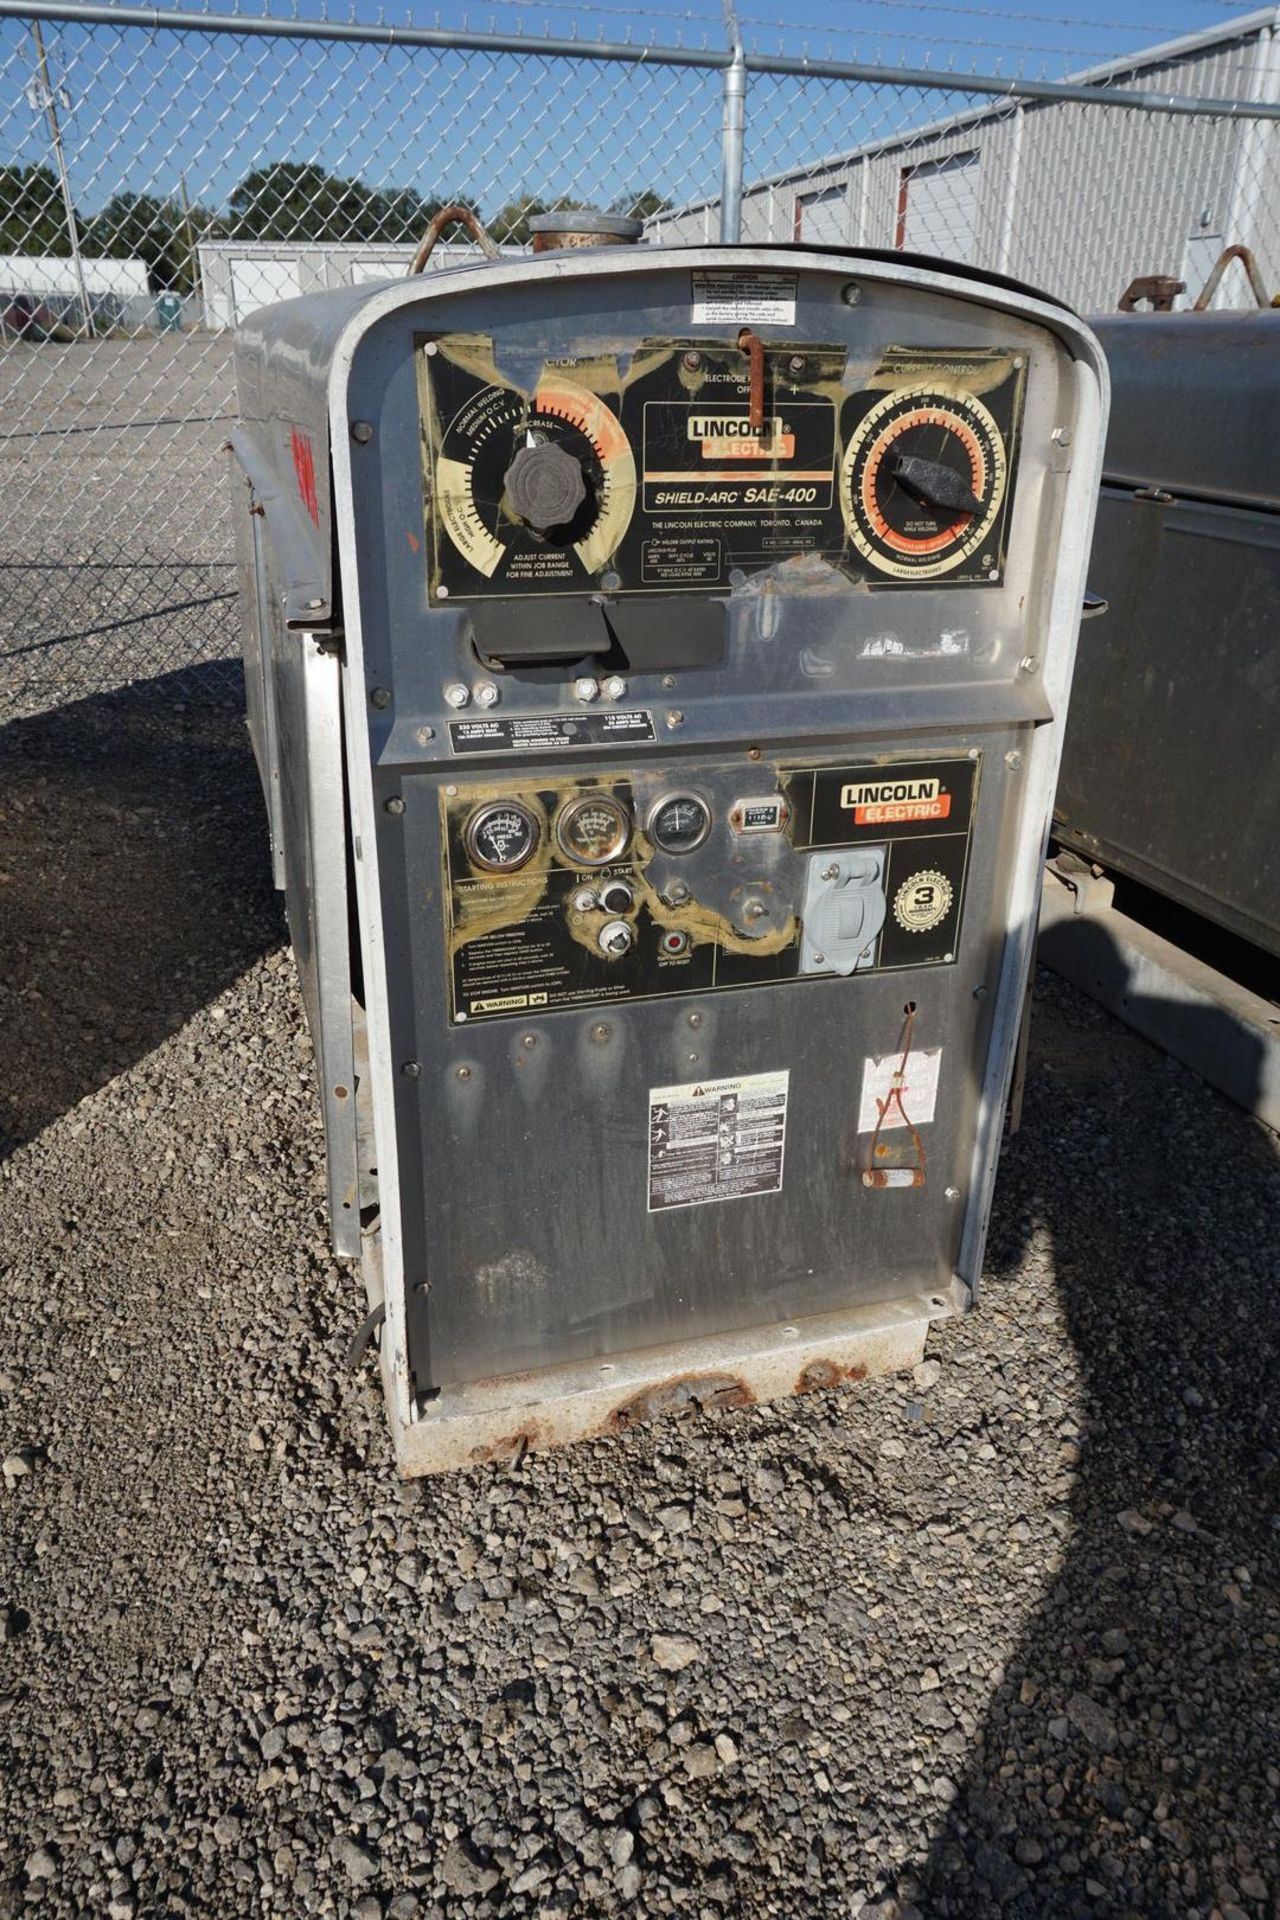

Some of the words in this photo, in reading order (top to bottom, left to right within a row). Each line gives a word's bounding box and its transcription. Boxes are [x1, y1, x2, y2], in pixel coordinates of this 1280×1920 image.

[704, 374, 746, 383] ELECTRODE
[456, 407, 480, 434] NORMAL
[476, 388, 505, 409] WELDING
[655, 492, 738, 504] SHIELD-ARC
[744, 488, 818, 503] SAE-400
[514, 553, 537, 562] ADJUST
[538, 552, 566, 562] CURRENT
[510, 562, 532, 570] WITHIN
[532, 562, 546, 570] JOB
[546, 561, 570, 570] RANGE
[518, 570, 534, 578] FINE
[534, 570, 574, 578] ADJUSTMENT
[846, 782, 934, 805] LINCOLN
[866, 804, 941, 821] ELECTRIC
[614, 868, 632, 876] START
[581, 874, 594, 882] ON
[914, 886, 935, 904] 3
[486, 998, 524, 1009] WARNING
[704, 1082, 742, 1094] WARNING
